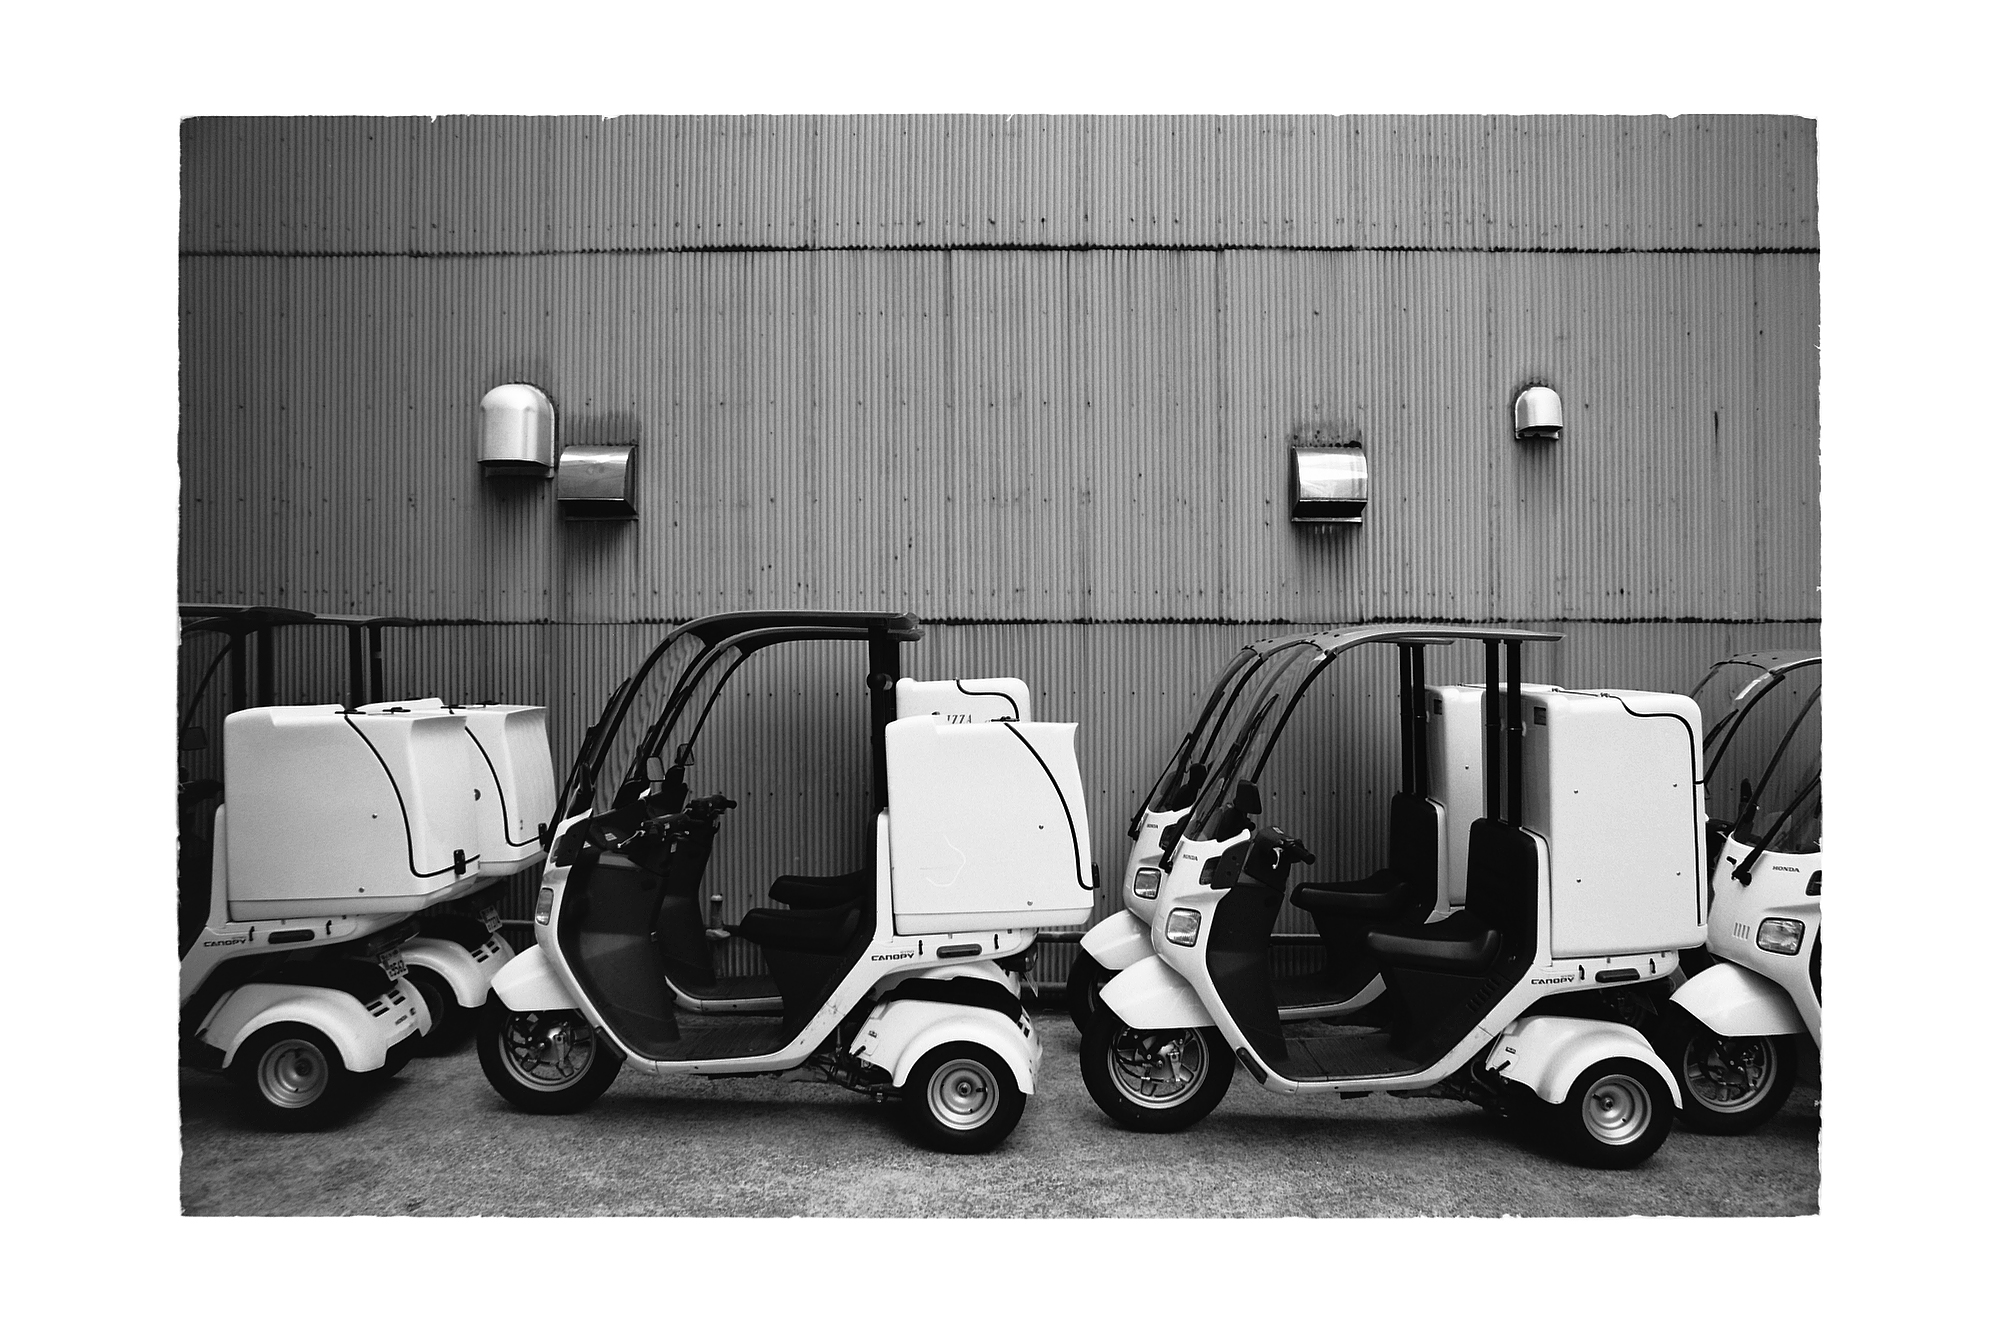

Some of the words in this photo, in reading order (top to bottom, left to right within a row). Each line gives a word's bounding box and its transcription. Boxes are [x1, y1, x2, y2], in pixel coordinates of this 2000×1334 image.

[1772, 865, 1800, 873] HONDA
[203, 938, 246, 948] CANOPY
[871, 952, 915, 962] CANOPY
[1531, 976, 1575, 985] CANOPY
